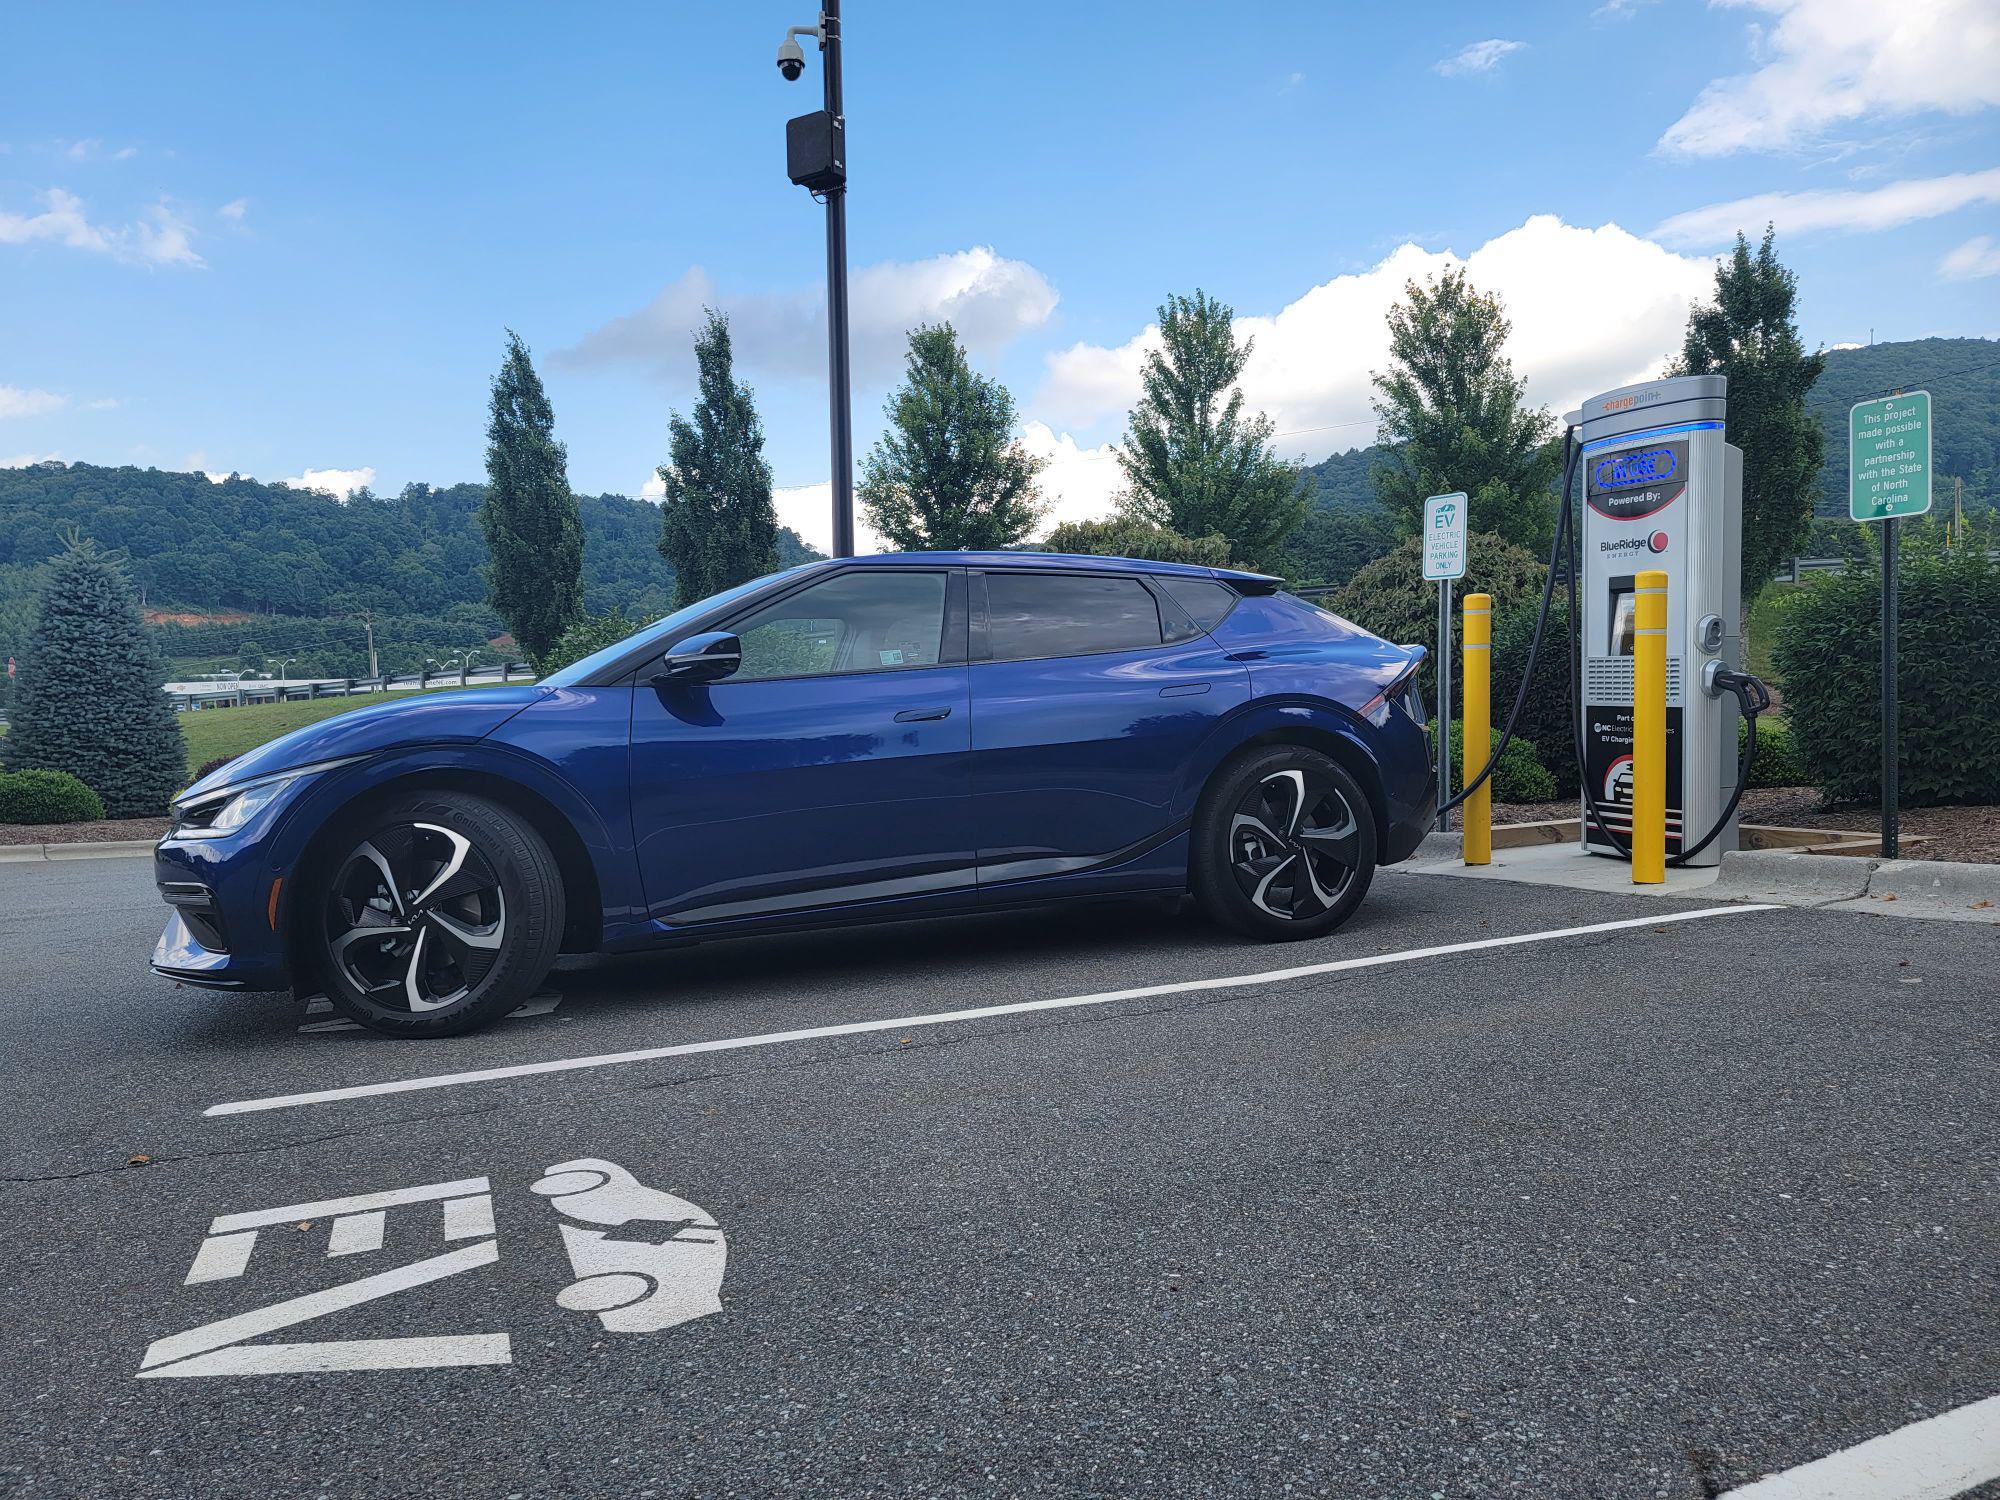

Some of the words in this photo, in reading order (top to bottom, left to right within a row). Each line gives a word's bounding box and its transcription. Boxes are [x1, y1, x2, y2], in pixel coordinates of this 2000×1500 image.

[1864, 414, 1881, 424] This
[1884, 407, 1916, 422] project
[1858, 428, 1882, 439] made
[1885, 421, 1922, 436] possible
[1875, 439, 1895, 450] with
[1898, 439, 1904, 447] a
[1864, 450, 1915, 467] partnership
[1614, 464, 1627, 479] IN
[1630, 459, 1657, 477] USE
[1858, 470, 1878, 480] with
[1881, 468, 1896, 477] the
[1899, 463, 1922, 474] State
[1871, 482, 1880, 492] of
[1883, 479, 1908, 490] North
[1608, 492, 1645, 506] Powered
[1646, 492, 1661, 502] By:
[1871, 493, 1908, 506] Carolina
[1435, 513, 1455, 529] EV
[1428, 531, 1461, 541] ELECTRIC
[1431, 541, 1458, 550] VEHICLE
[1600, 536, 1646, 551] BlueRidge
[1430, 550, 1458, 560] PARKING
[1606, 551, 1639, 559] ENERGY
[1435, 561, 1452, 570] ONLY
[1617, 714, 1630, 722] Part
[1611, 724, 1633, 733] Electric
[1611, 736, 1634, 745] Chargin
[453, 812, 500, 851] Continental
[134, 1176, 512, 1378] EV
